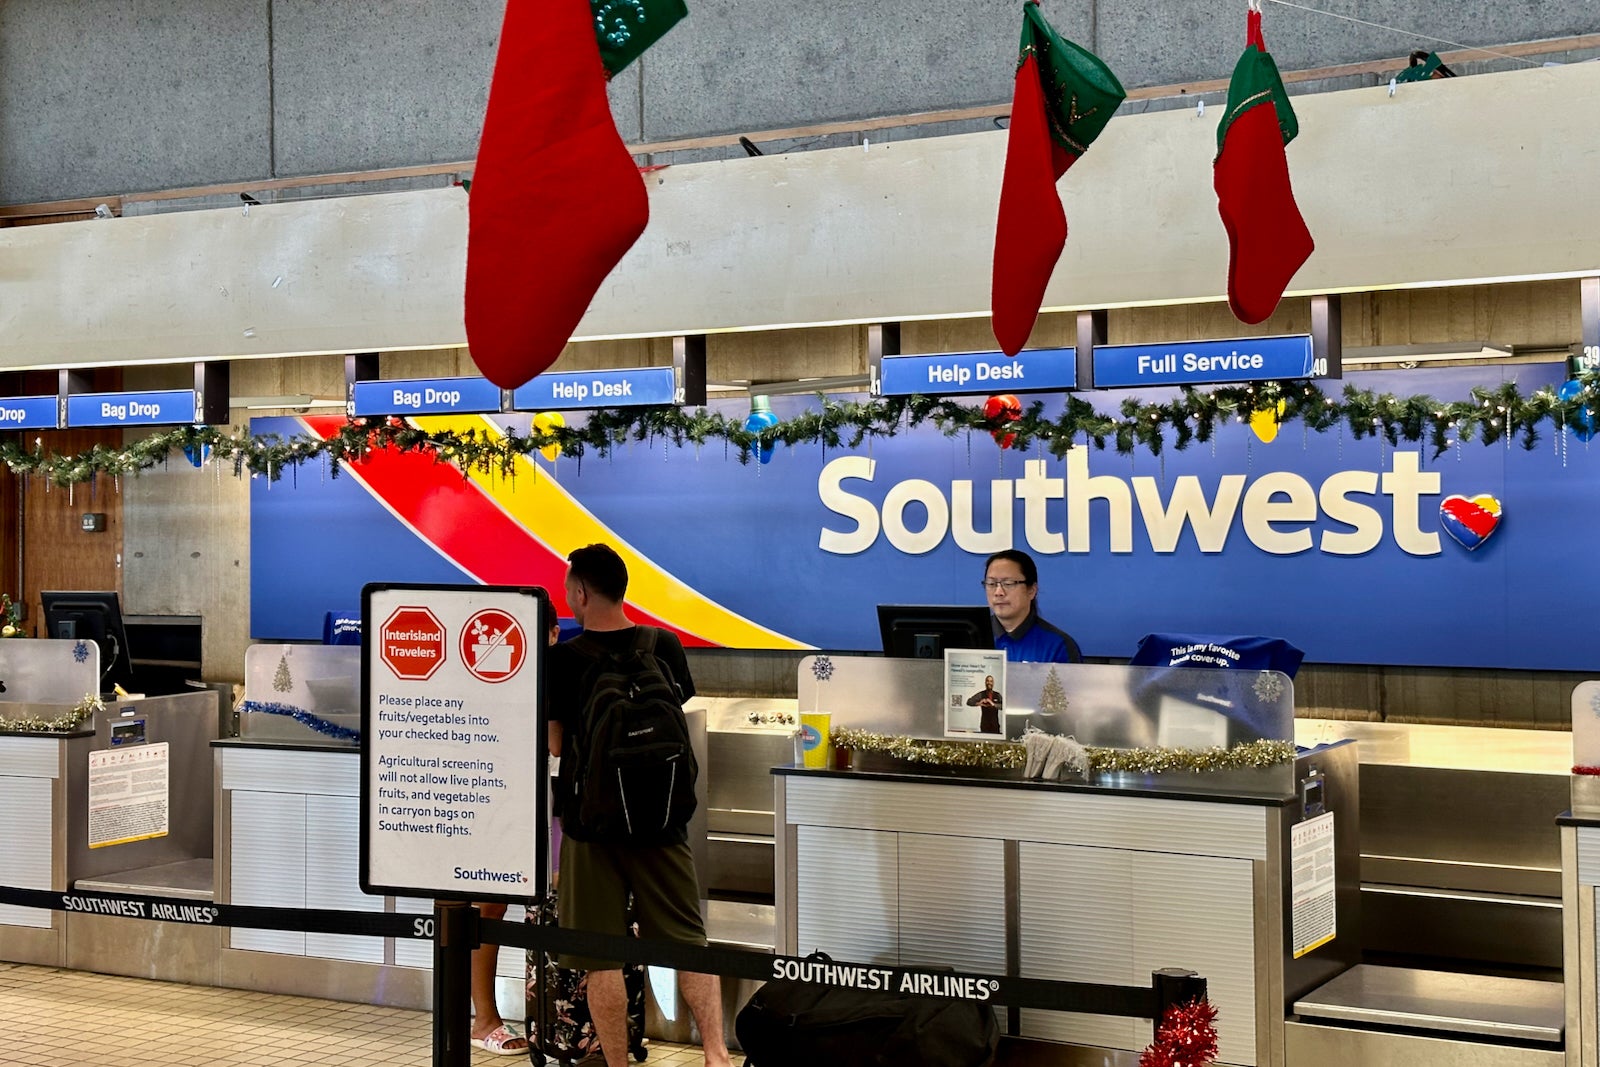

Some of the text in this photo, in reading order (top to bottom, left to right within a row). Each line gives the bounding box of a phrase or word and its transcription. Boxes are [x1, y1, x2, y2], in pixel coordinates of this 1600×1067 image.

[1137, 350, 1264, 374] Full Service
[1584, 346, 1600, 368] 39
[928, 361, 1024, 385] Help Desk
[1313, 357, 1328, 376] 40
[393, 388, 460, 408] Bag Drop
[552, 380, 632, 401] Help Desk
[101, 402, 160, 420] Bag Drop
[818, 445, 1441, 556] Southwest
[385, 629, 441, 642] Interisland
[389, 645, 436, 658] Travelers
[1171, 643, 1240, 660] This is my favorite
[1191, 654, 1229, 667] cover-up.
[379, 695, 464, 710] Please place any
[379, 711, 489, 726] fruits/vegetables into
[378, 728, 499, 744] your checked bag now.
[378, 755, 494, 773] Agricultural screening
[378, 772, 507, 789] will not allow live plants,
[378, 788, 490, 804] fruits, and vegetables
[378, 804, 475, 820] in carryon bags on
[378, 820, 472, 837] Southwest flights.
[454, 867, 522, 883] Southwest
[62, 896, 144, 917] SOUTHWEST
[772, 959, 893, 991] SOUTHWEST
